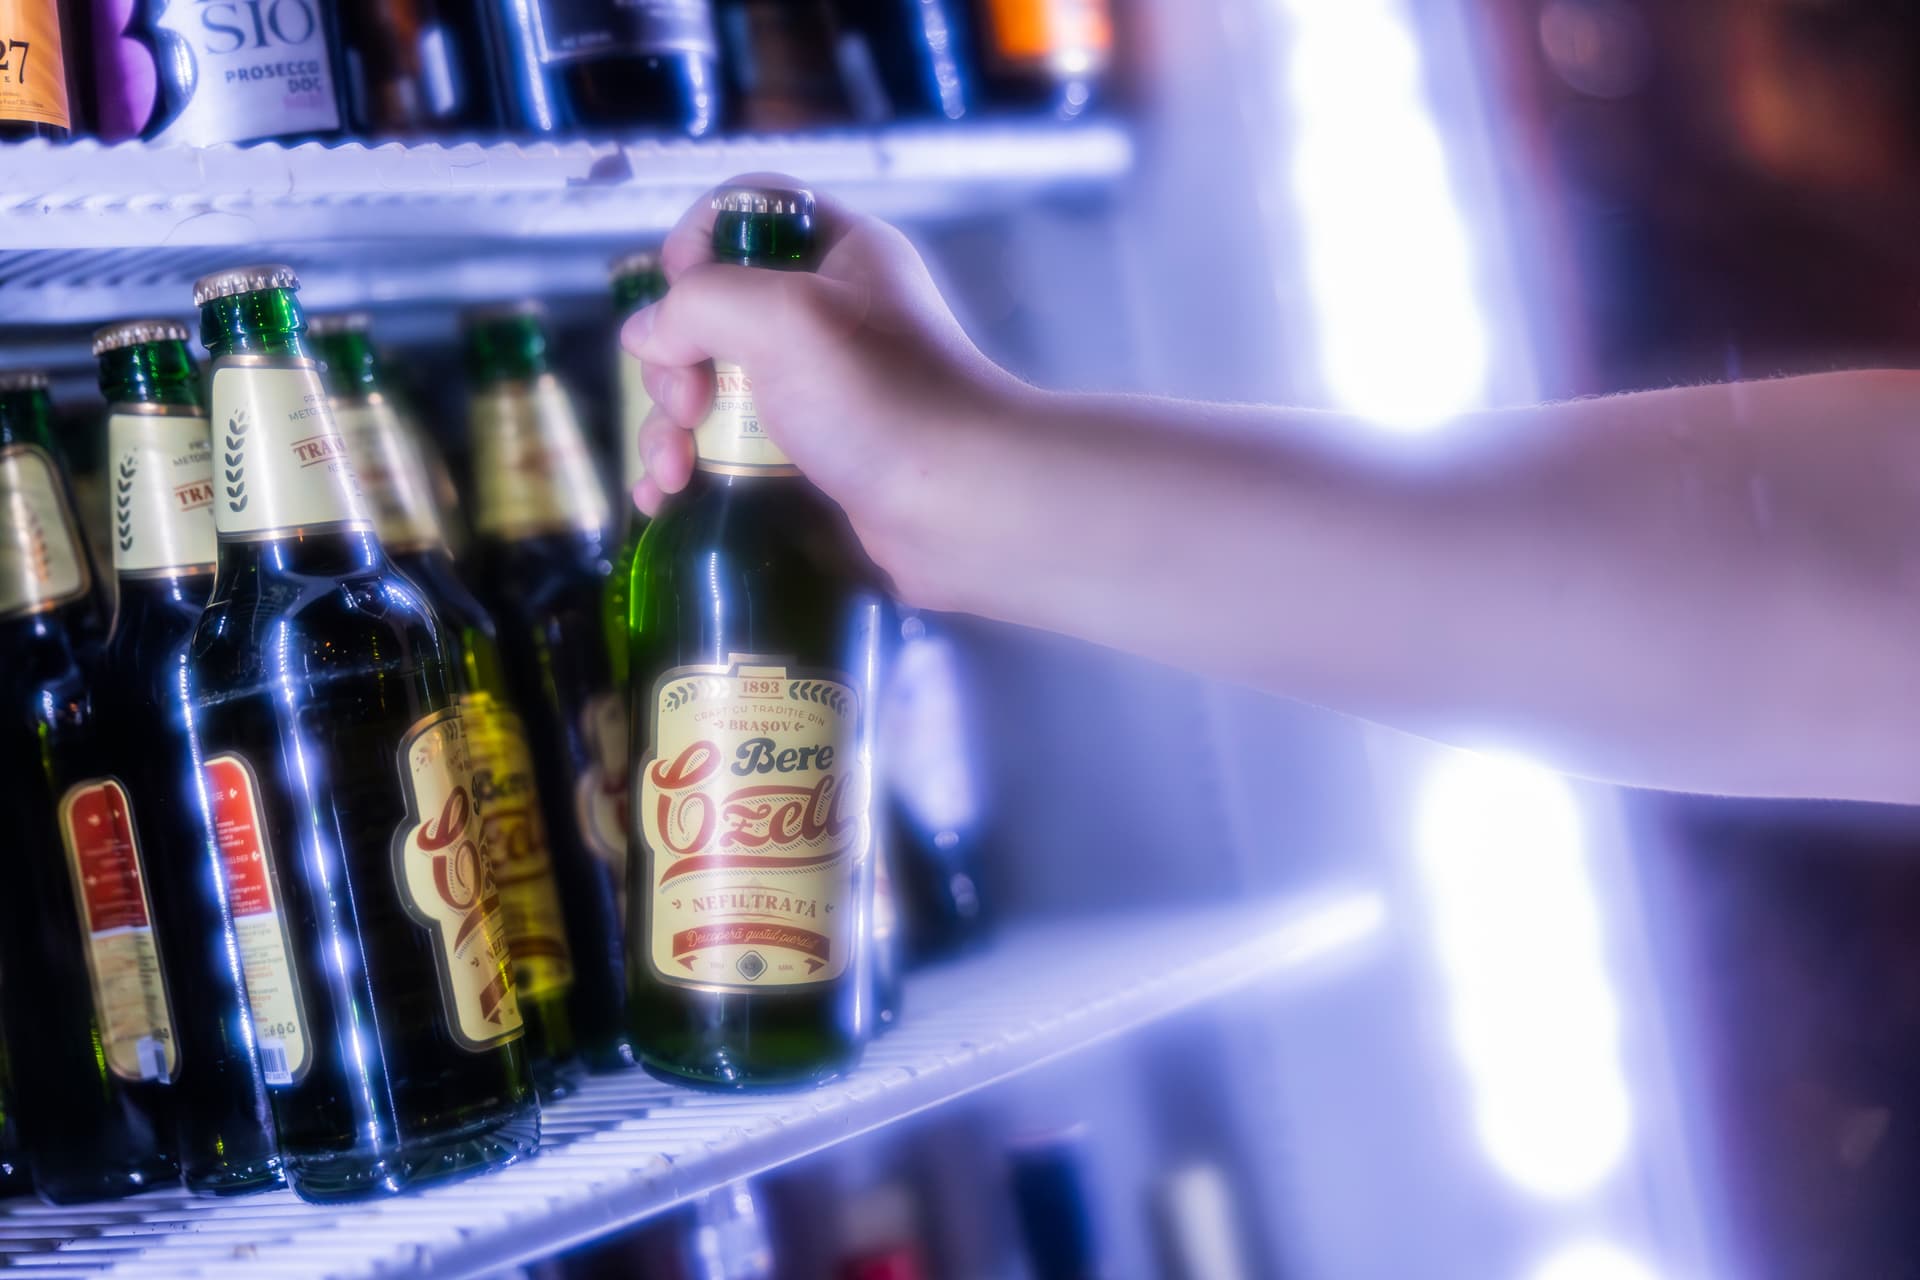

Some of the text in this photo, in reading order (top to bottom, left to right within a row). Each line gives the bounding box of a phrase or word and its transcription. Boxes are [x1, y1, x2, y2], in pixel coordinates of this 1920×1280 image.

[225, 60, 319, 84] PROSECCO
[742, 680, 780, 694] 1893
[694, 707, 729, 722] CRAFT
[732, 704, 748, 714] CU
[807, 713, 825, 727] DIN
[730, 737, 835, 777] Bere
